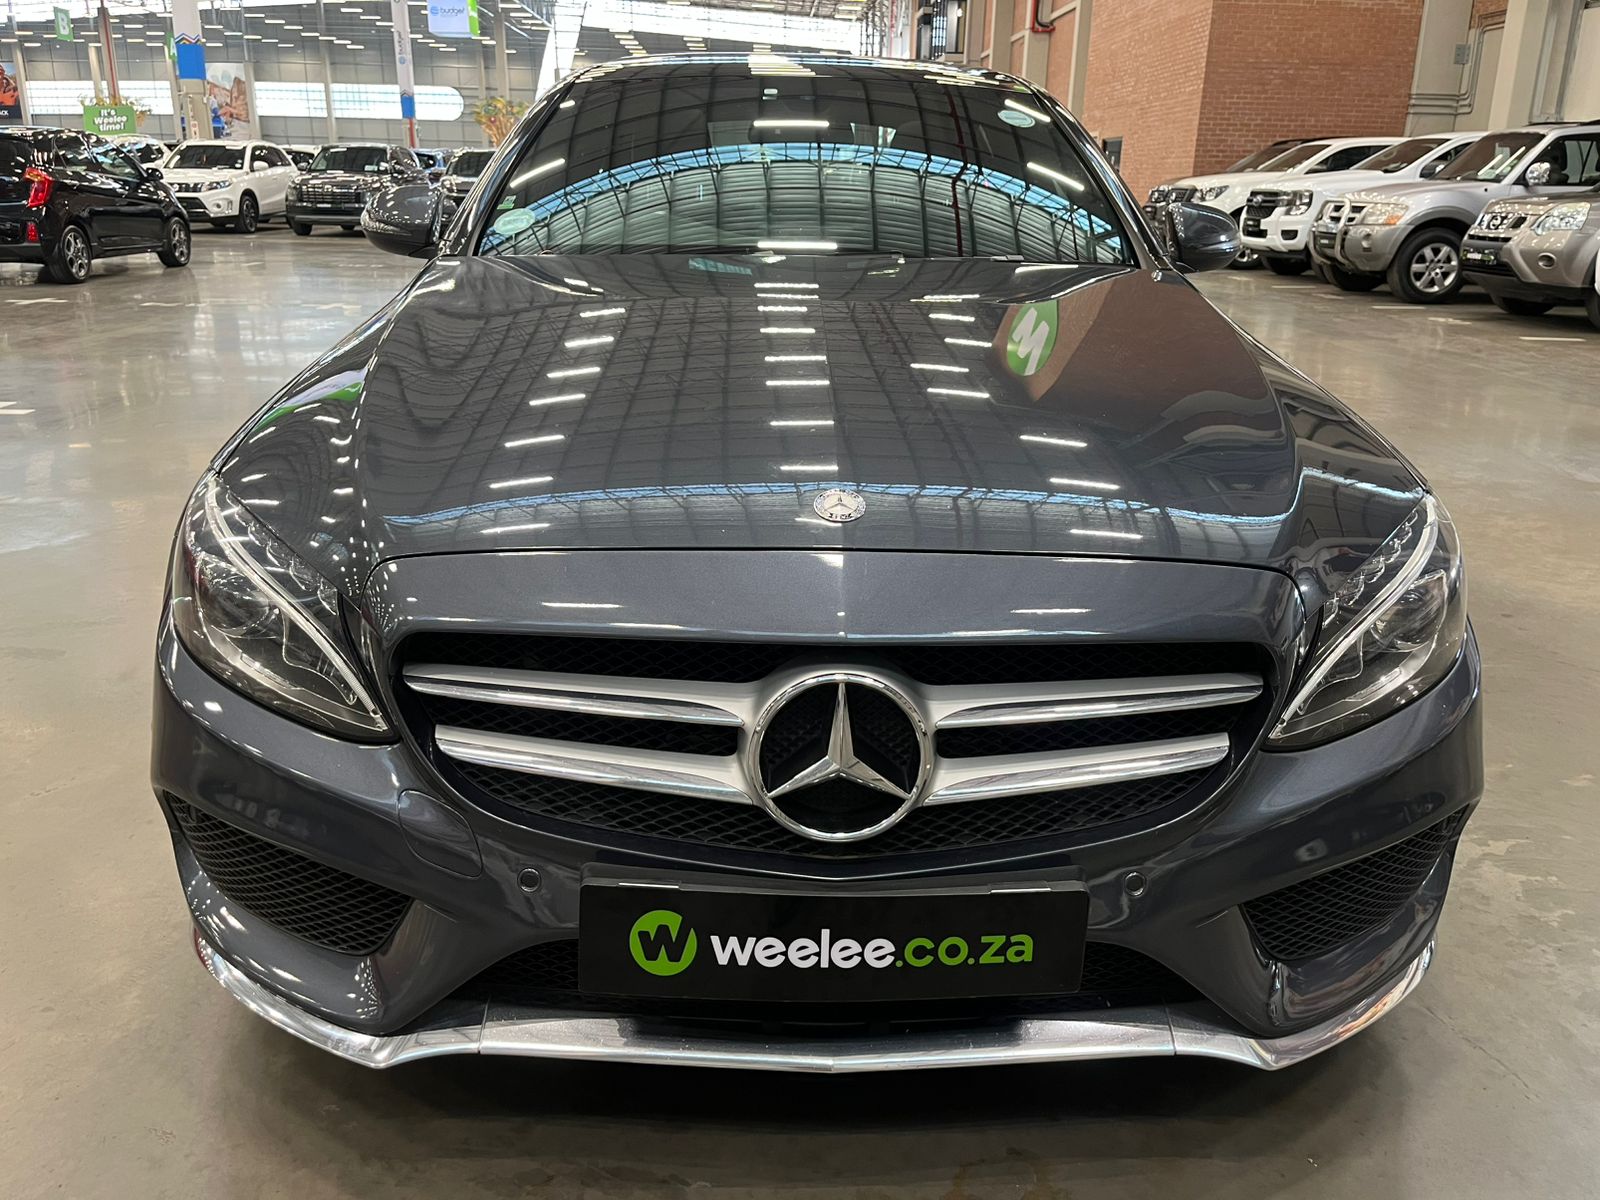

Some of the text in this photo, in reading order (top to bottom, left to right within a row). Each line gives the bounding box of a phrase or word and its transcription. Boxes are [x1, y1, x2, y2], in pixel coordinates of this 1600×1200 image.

[440, 6, 465, 16] budget
[57, 12, 70, 35] B
[710, 928, 1034, 969] weelee.co.za
